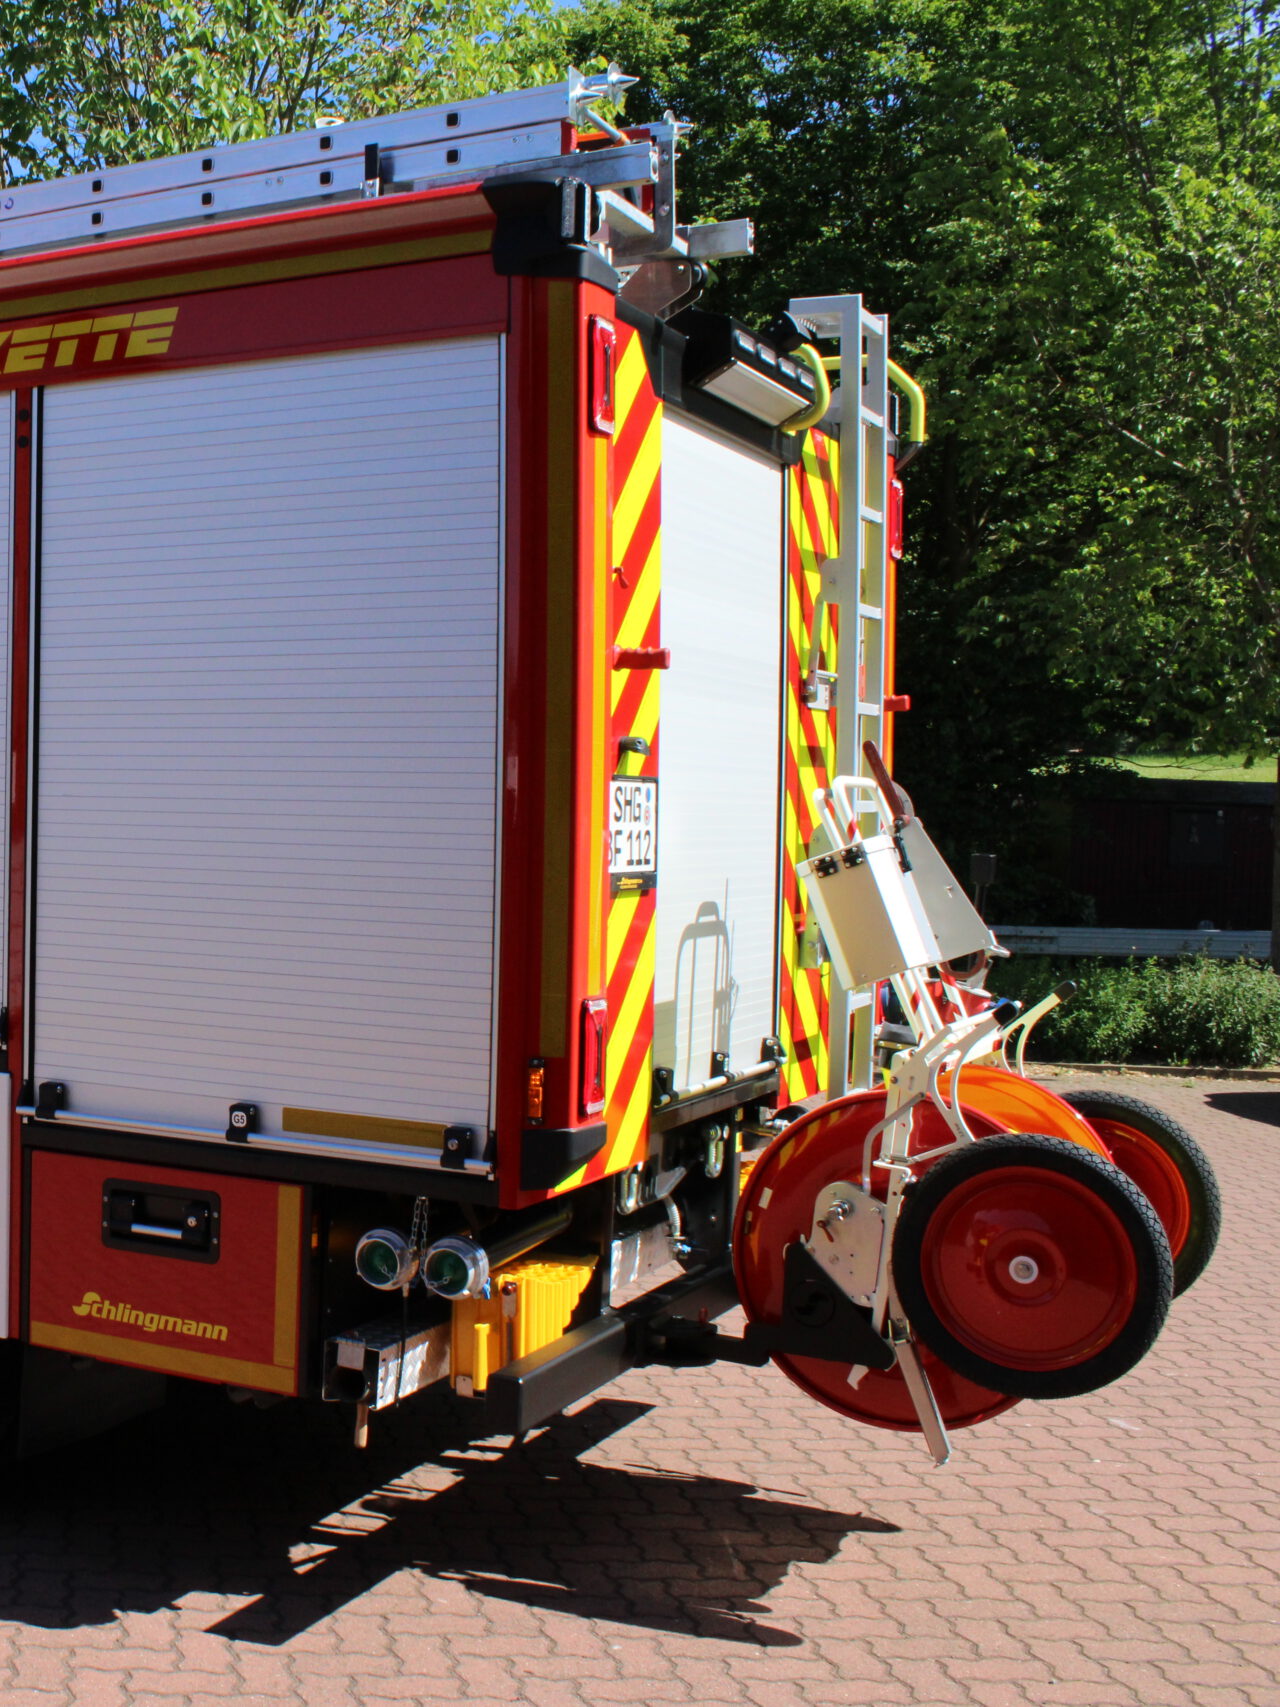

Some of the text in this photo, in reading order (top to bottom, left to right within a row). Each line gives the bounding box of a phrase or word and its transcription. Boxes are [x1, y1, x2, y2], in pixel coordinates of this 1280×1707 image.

[613, 786, 641, 823] SHG
[626, 829, 652, 866] 112
[233, 1114, 245, 1125] G5
[72, 1291, 228, 1341] Schlingmann
